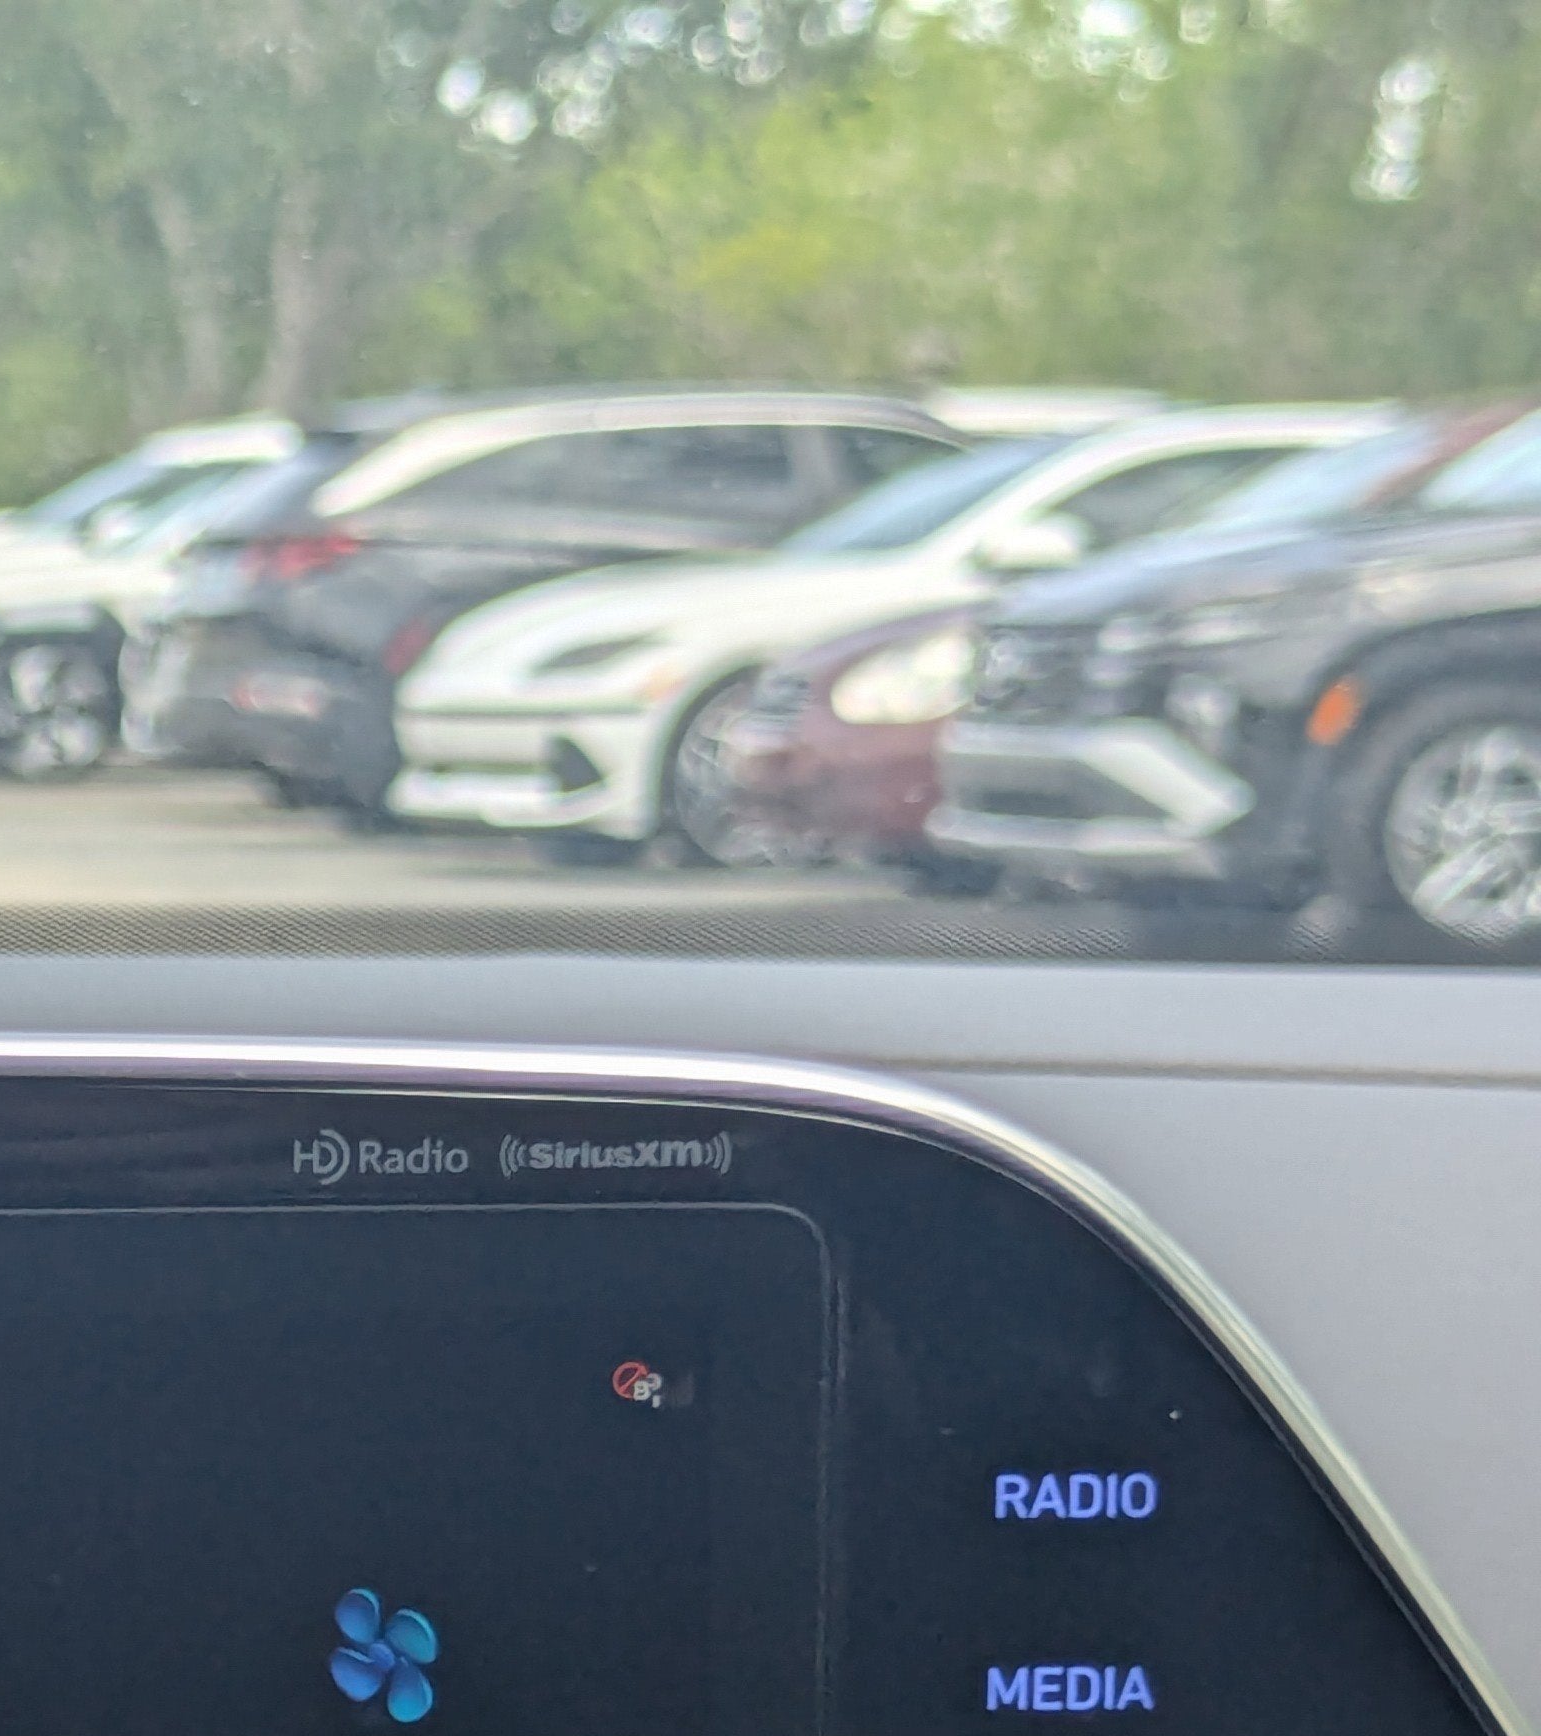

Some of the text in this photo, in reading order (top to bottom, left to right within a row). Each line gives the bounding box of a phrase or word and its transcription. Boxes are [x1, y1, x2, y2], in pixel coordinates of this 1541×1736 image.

[358, 1137, 469, 1174] Radio
[994, 1472, 1157, 1519] RADIO
[986, 1665, 1154, 1711] MEDIA
